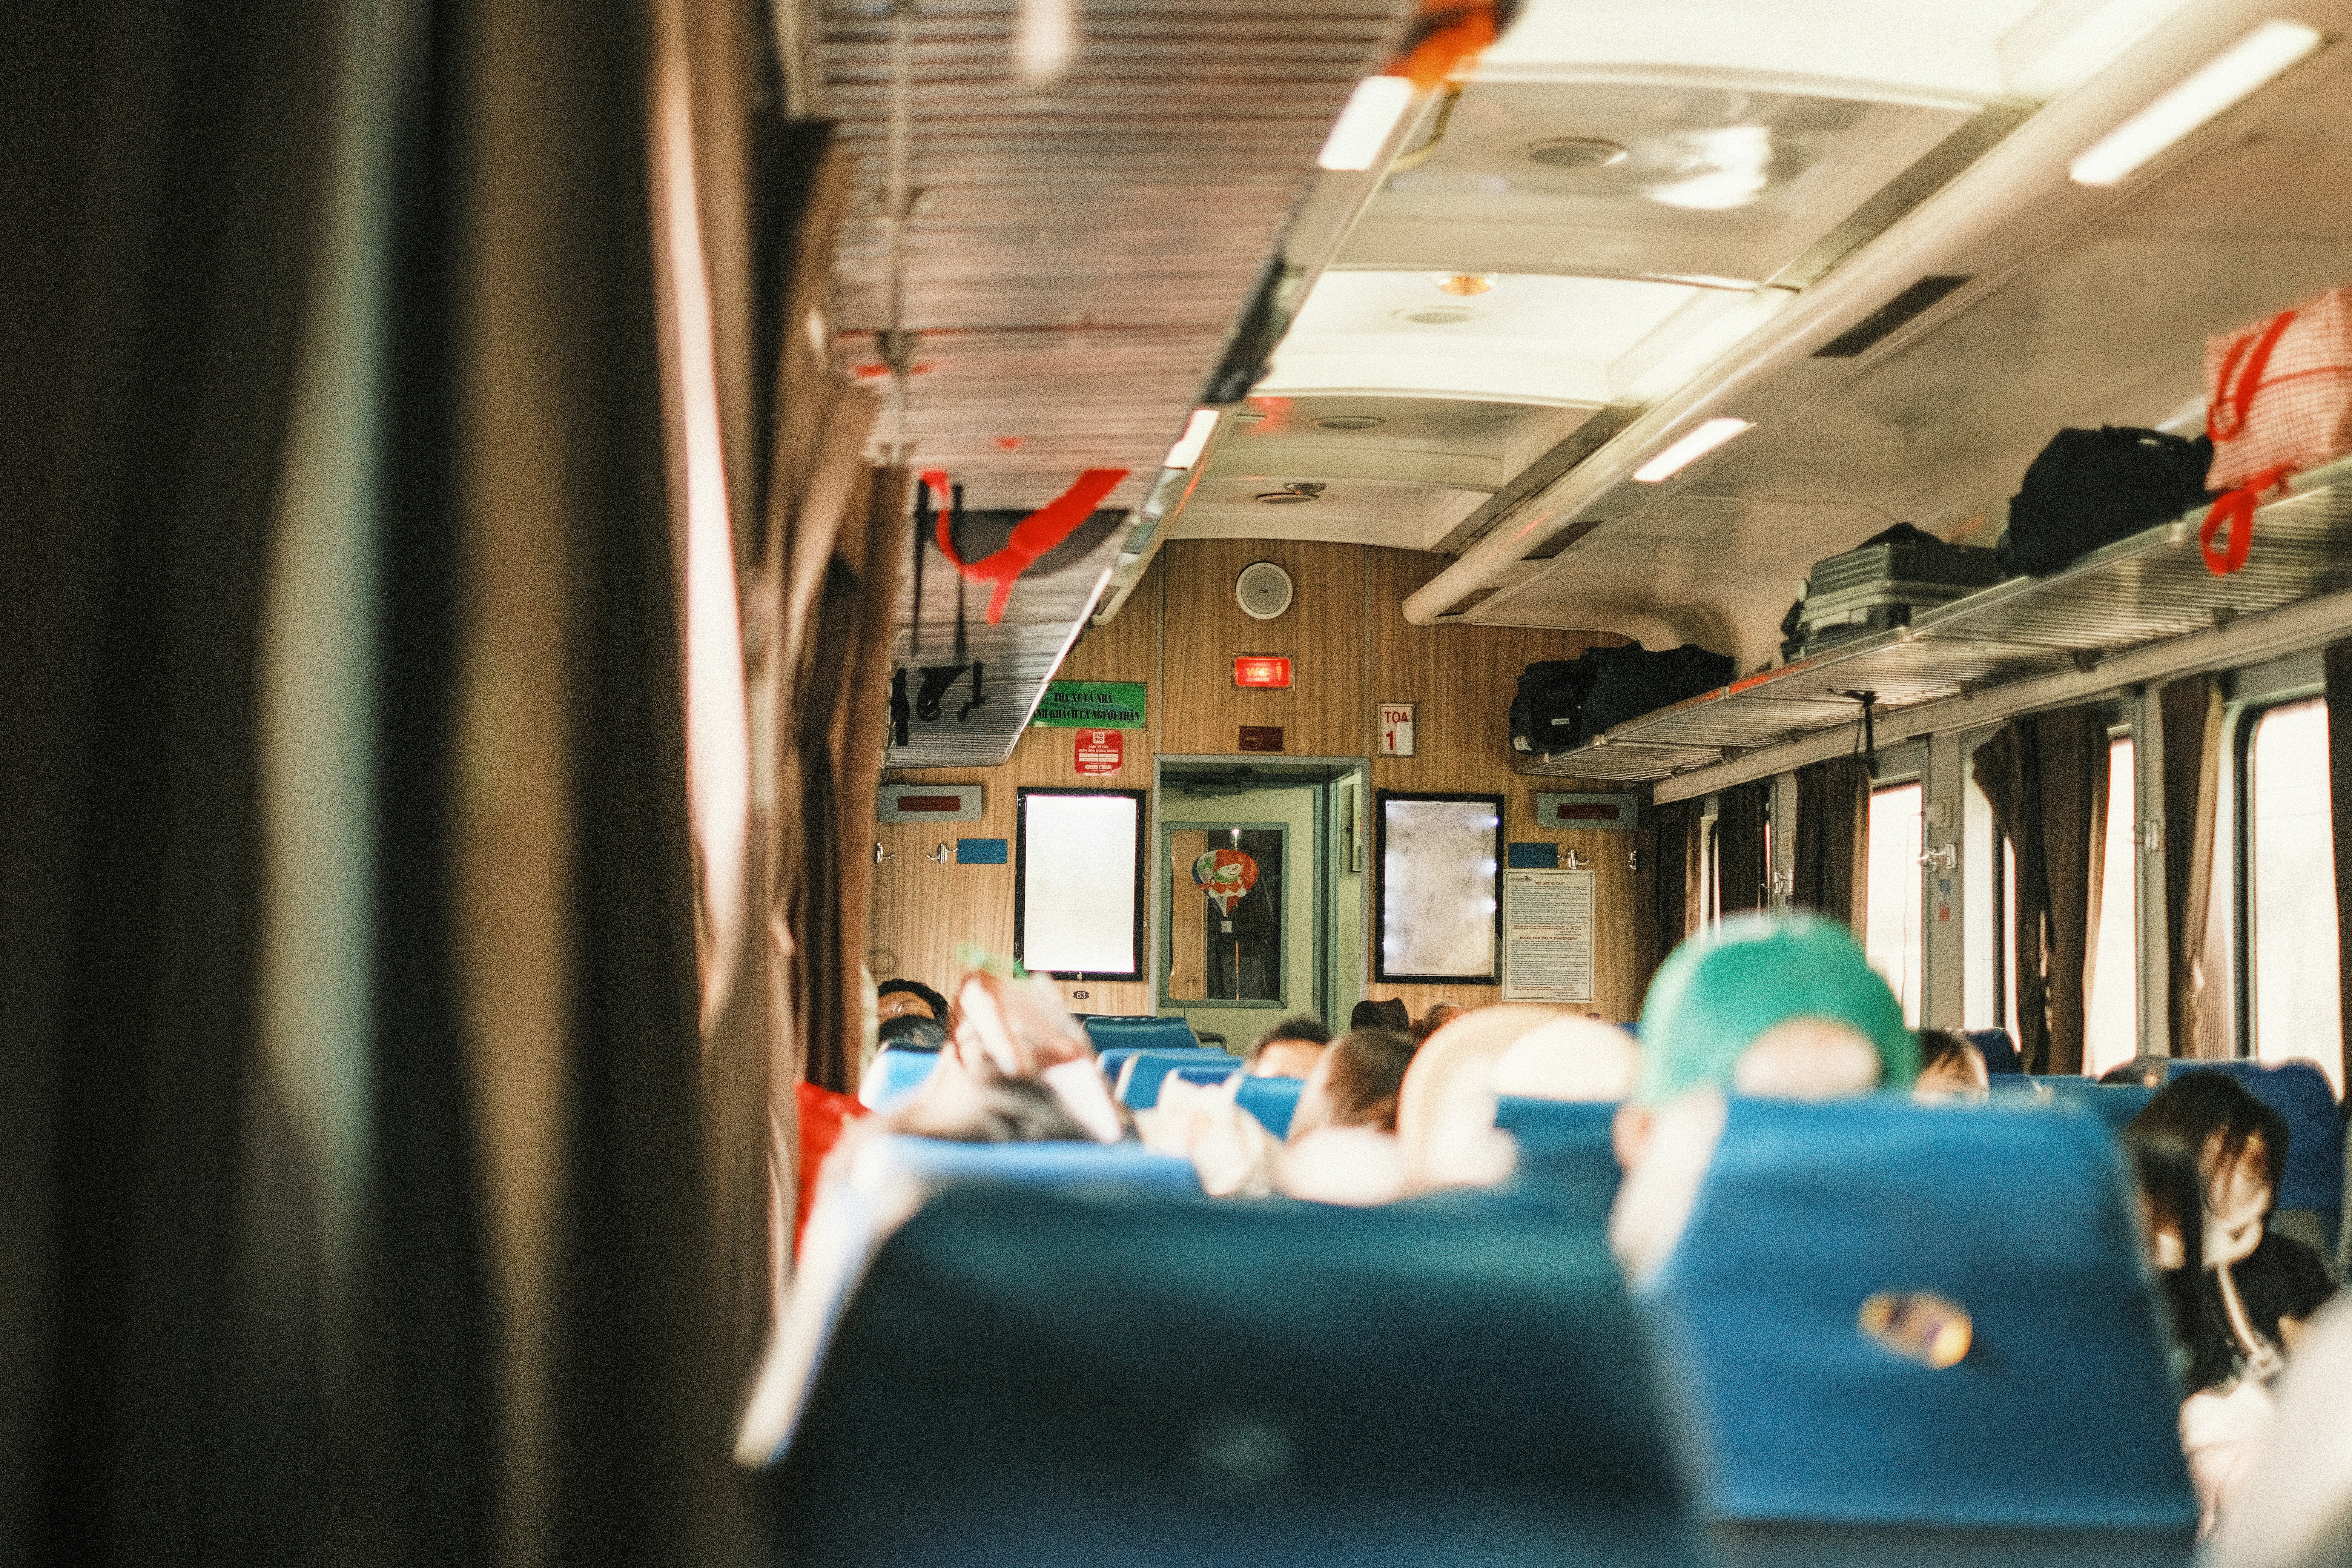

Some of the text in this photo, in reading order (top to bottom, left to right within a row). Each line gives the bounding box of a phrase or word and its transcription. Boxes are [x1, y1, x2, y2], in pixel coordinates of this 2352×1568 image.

[1246, 667, 1269, 676] WC
[1072, 693, 1082, 702] XE
[1384, 711, 1408, 723] TOA
[1386, 731, 1394, 750] 1
